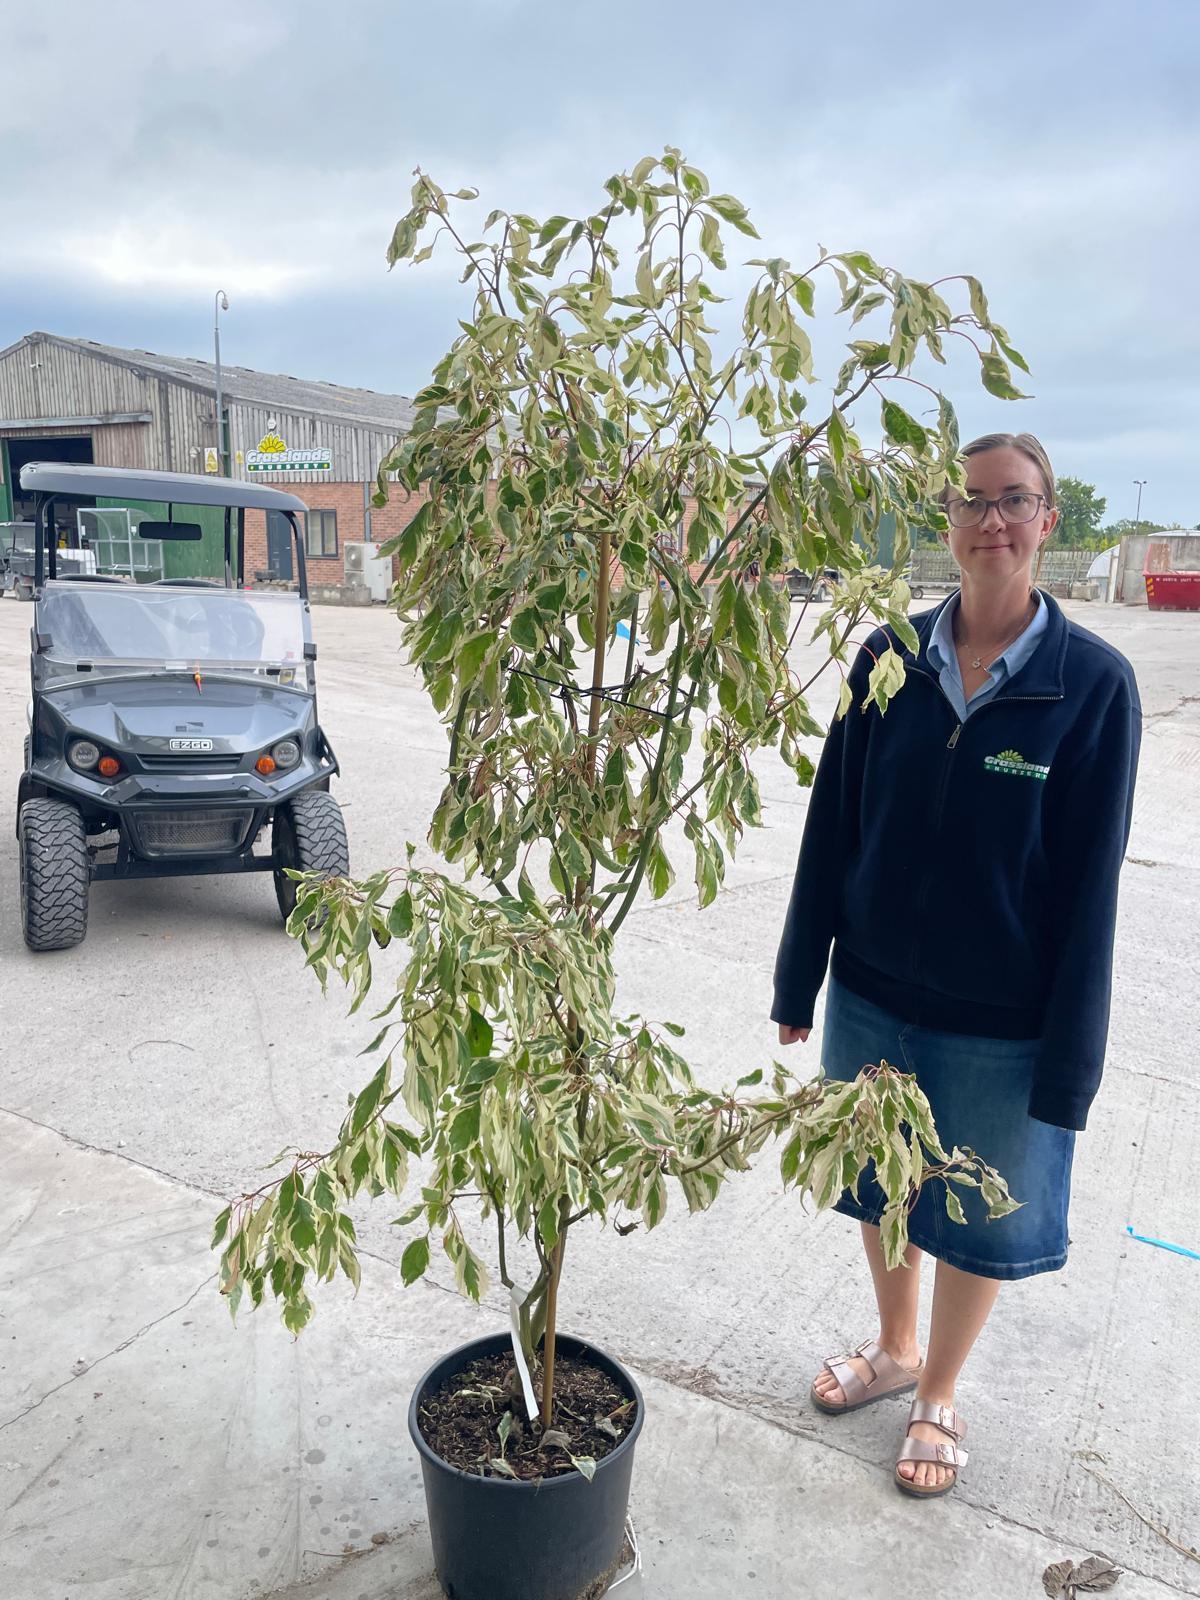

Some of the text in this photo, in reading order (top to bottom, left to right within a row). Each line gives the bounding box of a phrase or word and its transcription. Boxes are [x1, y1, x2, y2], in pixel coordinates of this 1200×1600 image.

[246, 449, 331, 463] Grasslands
[171, 740, 211, 750] EZGO
[984, 755, 1051, 775] Grassland
